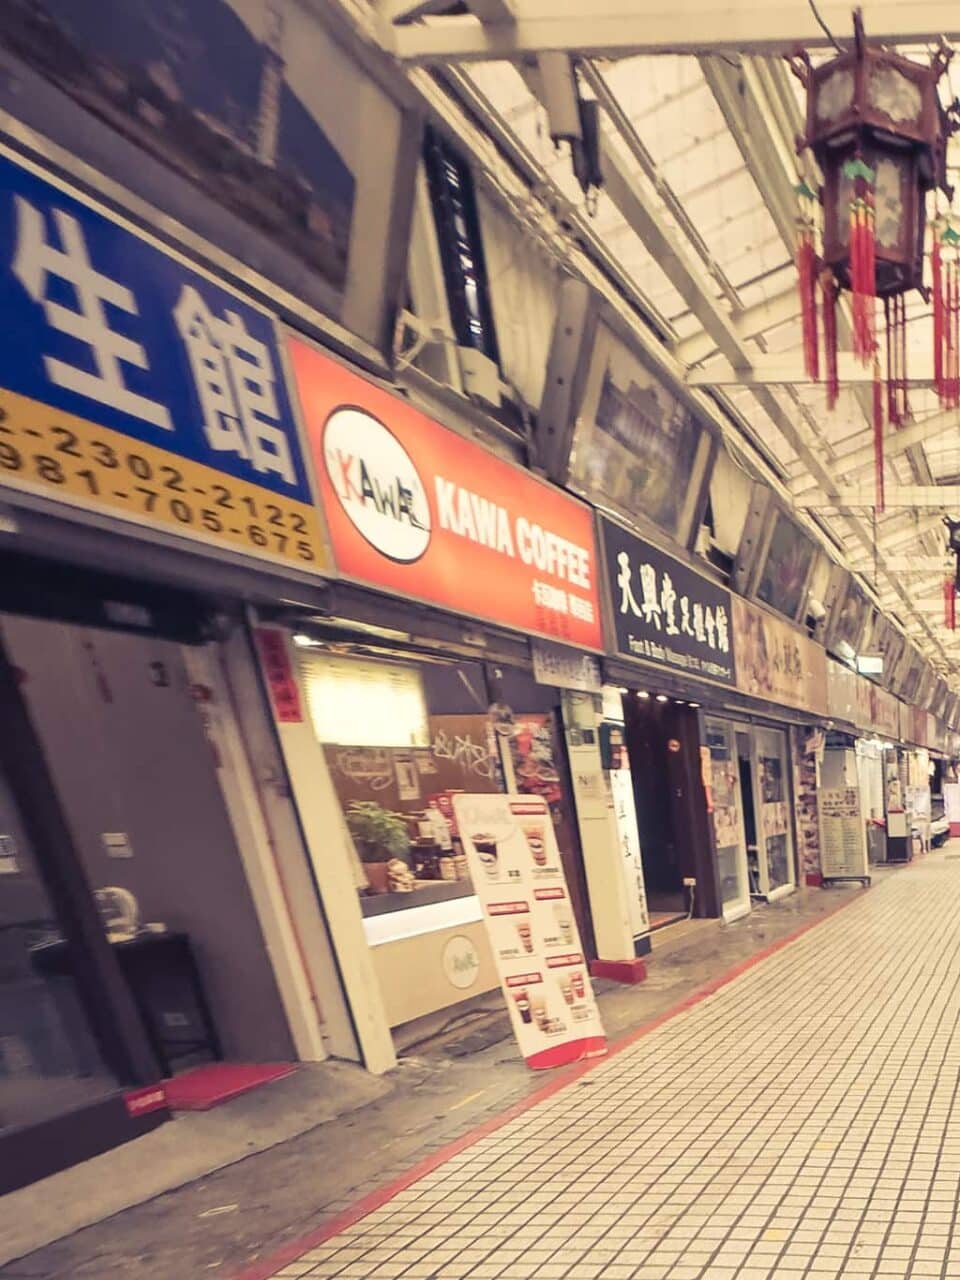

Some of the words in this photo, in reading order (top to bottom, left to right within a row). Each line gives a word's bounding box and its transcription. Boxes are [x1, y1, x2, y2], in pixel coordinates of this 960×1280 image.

[11, 193, 298, 487] 生館
[434, 474, 515, 558] KAWA
[515, 516, 592, 590] COFFEE
